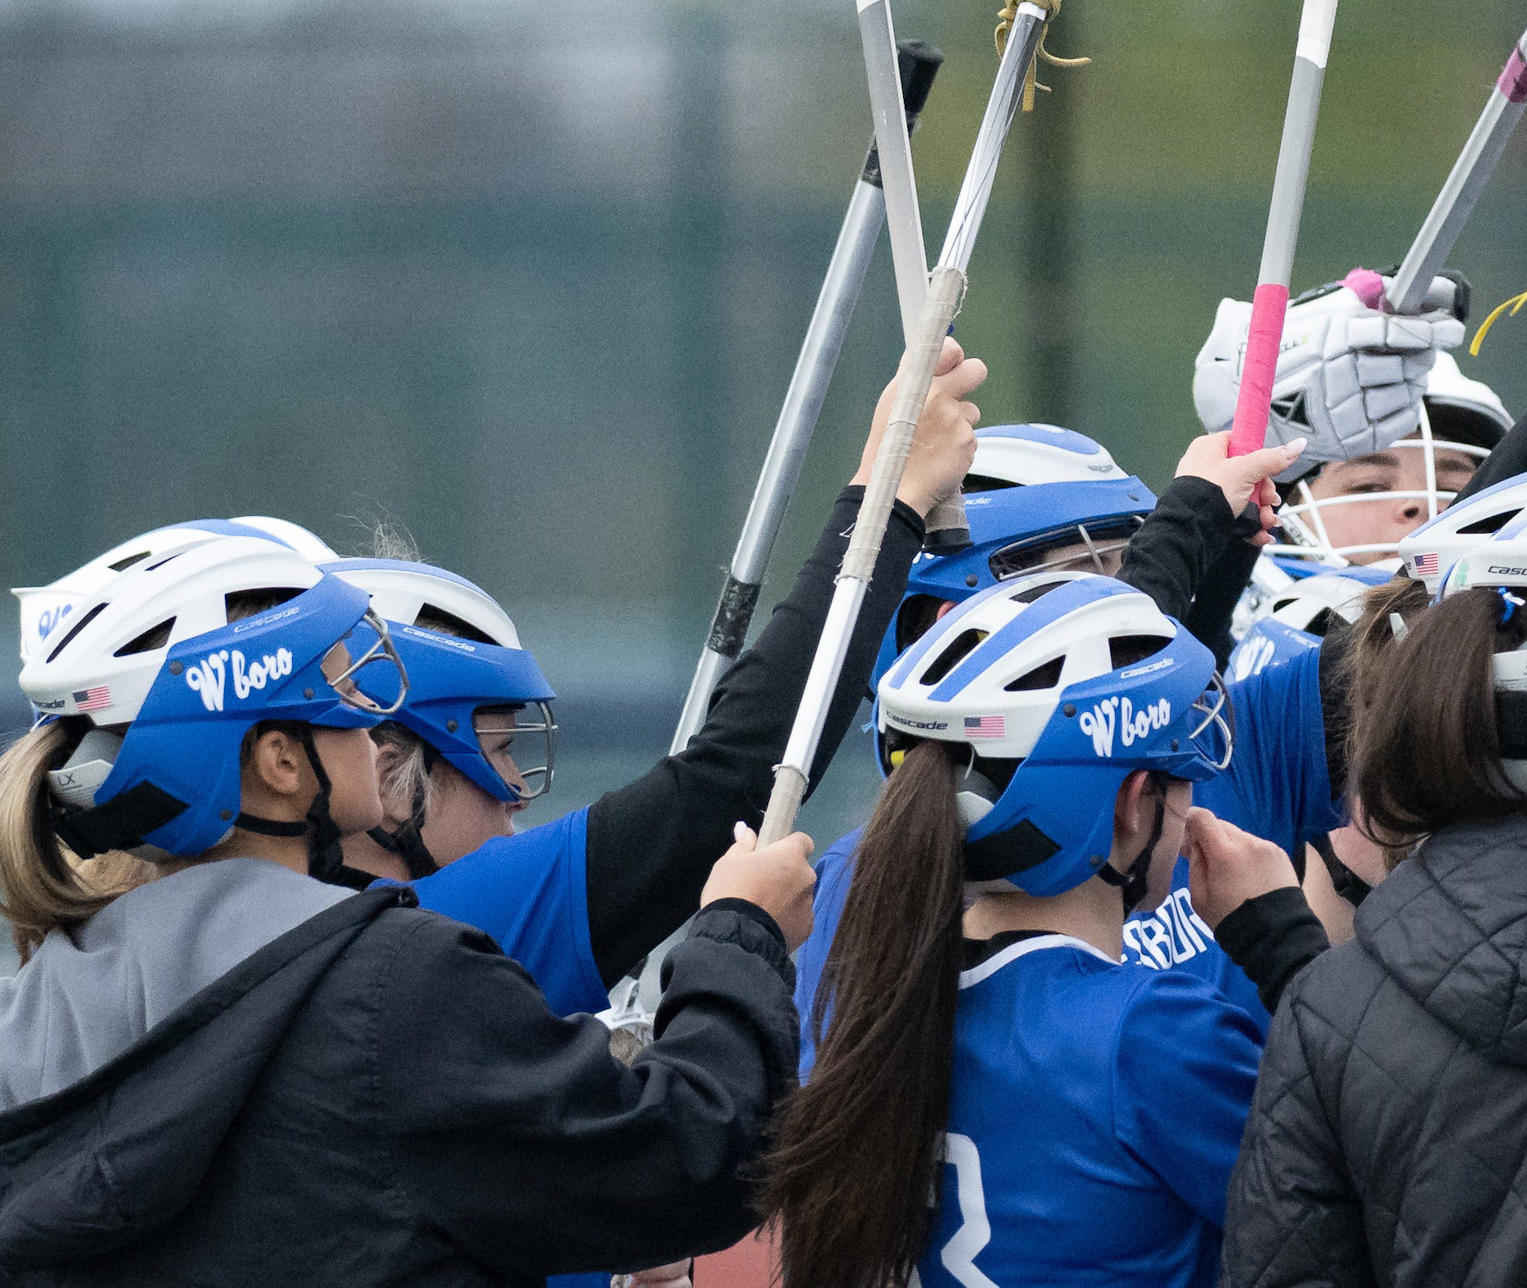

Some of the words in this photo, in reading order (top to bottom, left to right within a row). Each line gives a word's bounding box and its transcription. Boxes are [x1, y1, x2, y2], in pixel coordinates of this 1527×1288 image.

[233, 607, 300, 634] cascade
[402, 626, 477, 653] cascade
[185, 648, 294, 712] W'boro
[1120, 657, 1175, 679] cascade
[885, 710, 949, 732] cascade
[1080, 696, 1172, 758] W'boro
[59, 772, 76, 787] LX
